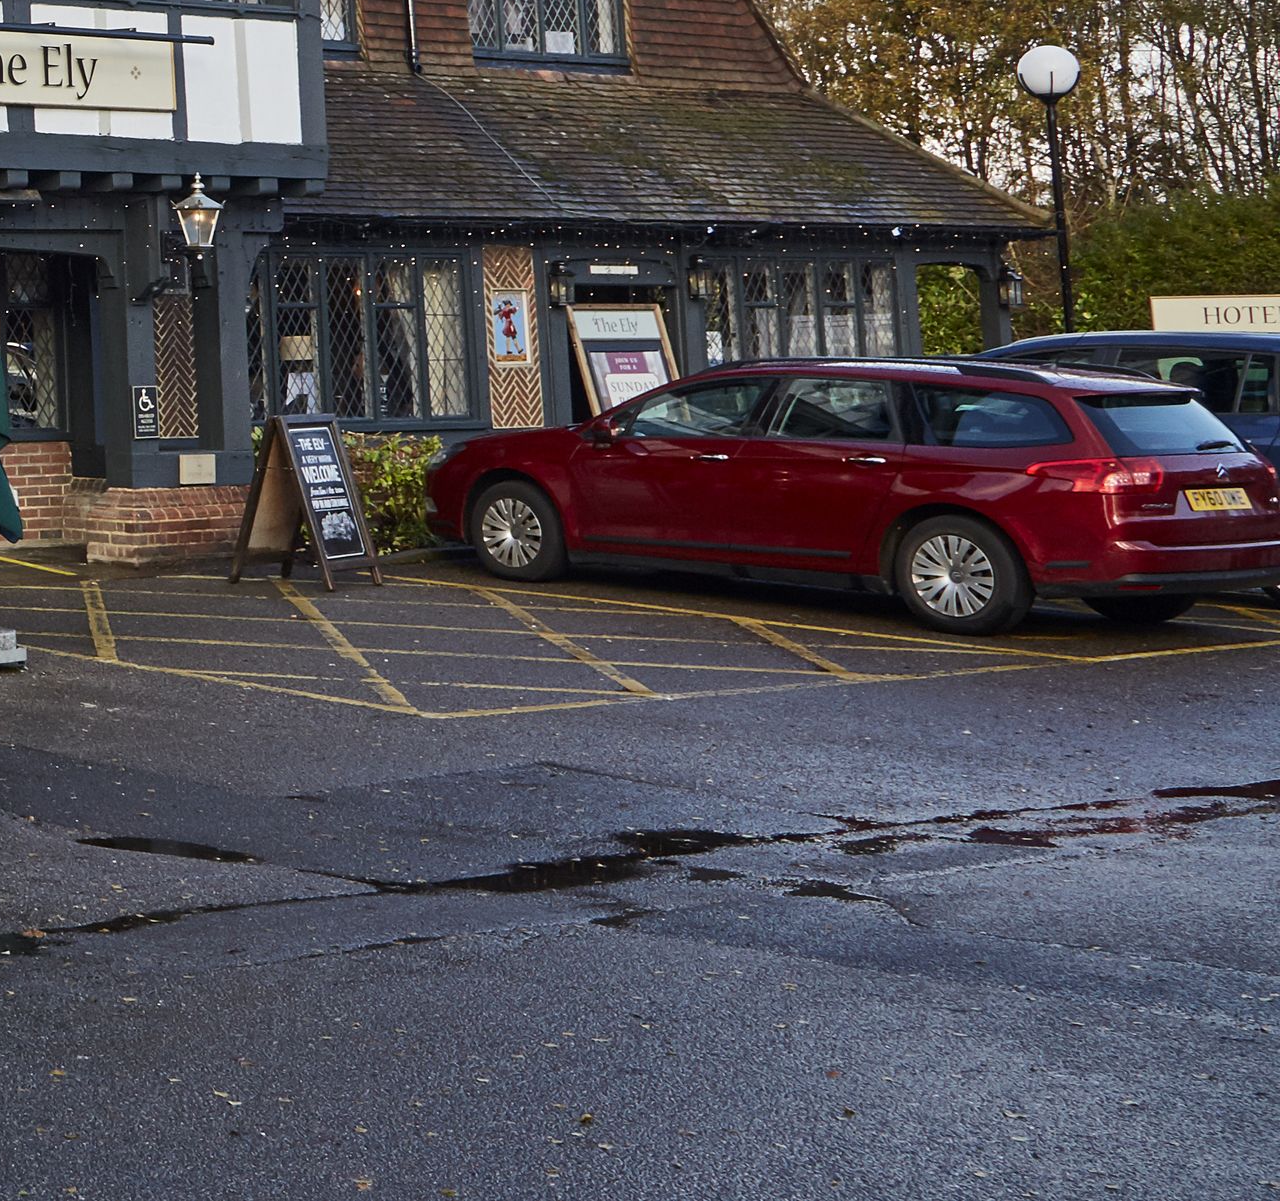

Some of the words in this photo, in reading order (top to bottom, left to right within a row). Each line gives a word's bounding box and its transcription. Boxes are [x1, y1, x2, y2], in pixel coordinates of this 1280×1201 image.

[40, 43, 99, 100] Ely
[1201, 305, 1280, 325] HOTE
[593, 316, 618, 333] The
[619, 317, 639, 336] Ely
[610, 380, 656, 393] SUNDAY
[298, 438, 313, 451] THE
[312, 438, 325, 450] ELY
[301, 465, 341, 483] WELCOME
